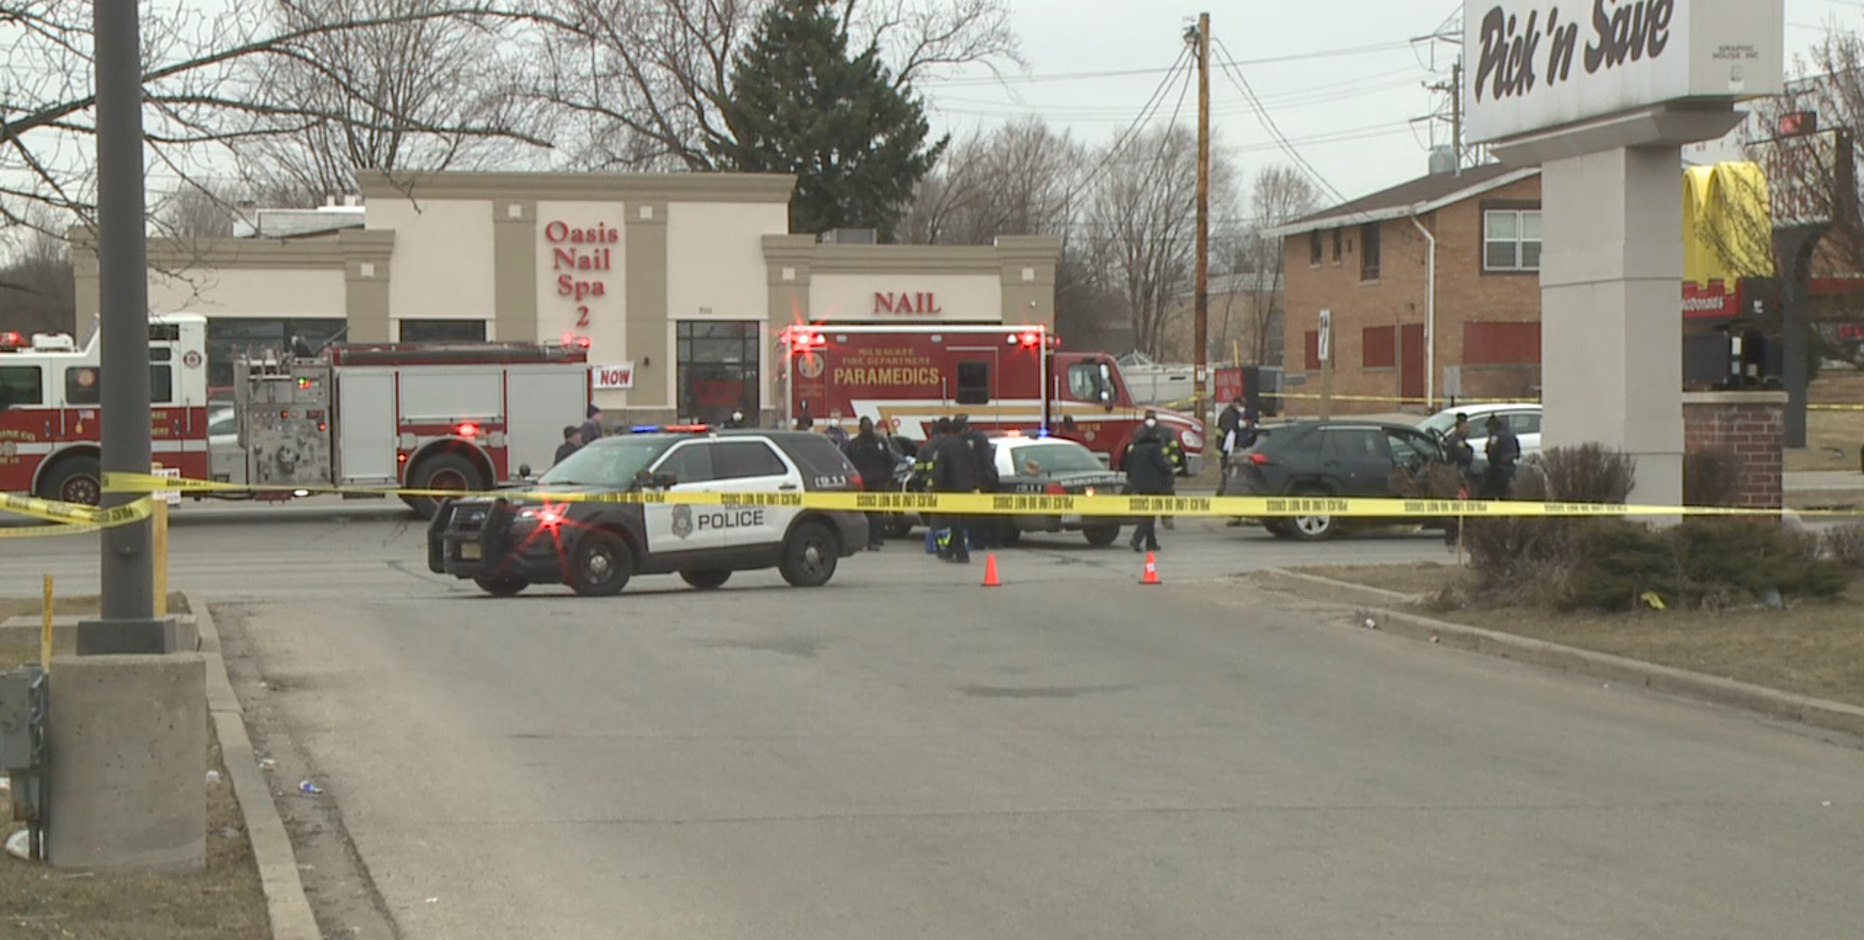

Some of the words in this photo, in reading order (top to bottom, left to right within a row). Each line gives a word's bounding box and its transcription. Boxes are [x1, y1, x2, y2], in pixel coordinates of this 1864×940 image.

[1475, 5, 1541, 105] Pick
[1546, 6, 1578, 87] 'n
[1584, 0, 1674, 74] Save
[545, 220, 619, 244] Oasis
[552, 247, 611, 271] Nail
[557, 273, 606, 302] Spa
[874, 291, 942, 314] NAIL
[575, 305, 590, 328] 2
[842, 356, 864, 365] FIRE
[867, 356, 931, 365] DEPARTMENT
[599, 369, 631, 386] NOW
[834, 367, 940, 385] PARAMEDICS
[781, 493, 802, 505] POLICE
[917, 494, 938, 508] POLICE
[1053, 496, 1074, 510] POLICE
[1190, 498, 1210, 511] POLICE
[1327, 499, 1348, 512] POLICE
[698, 510, 764, 530] POLICE
